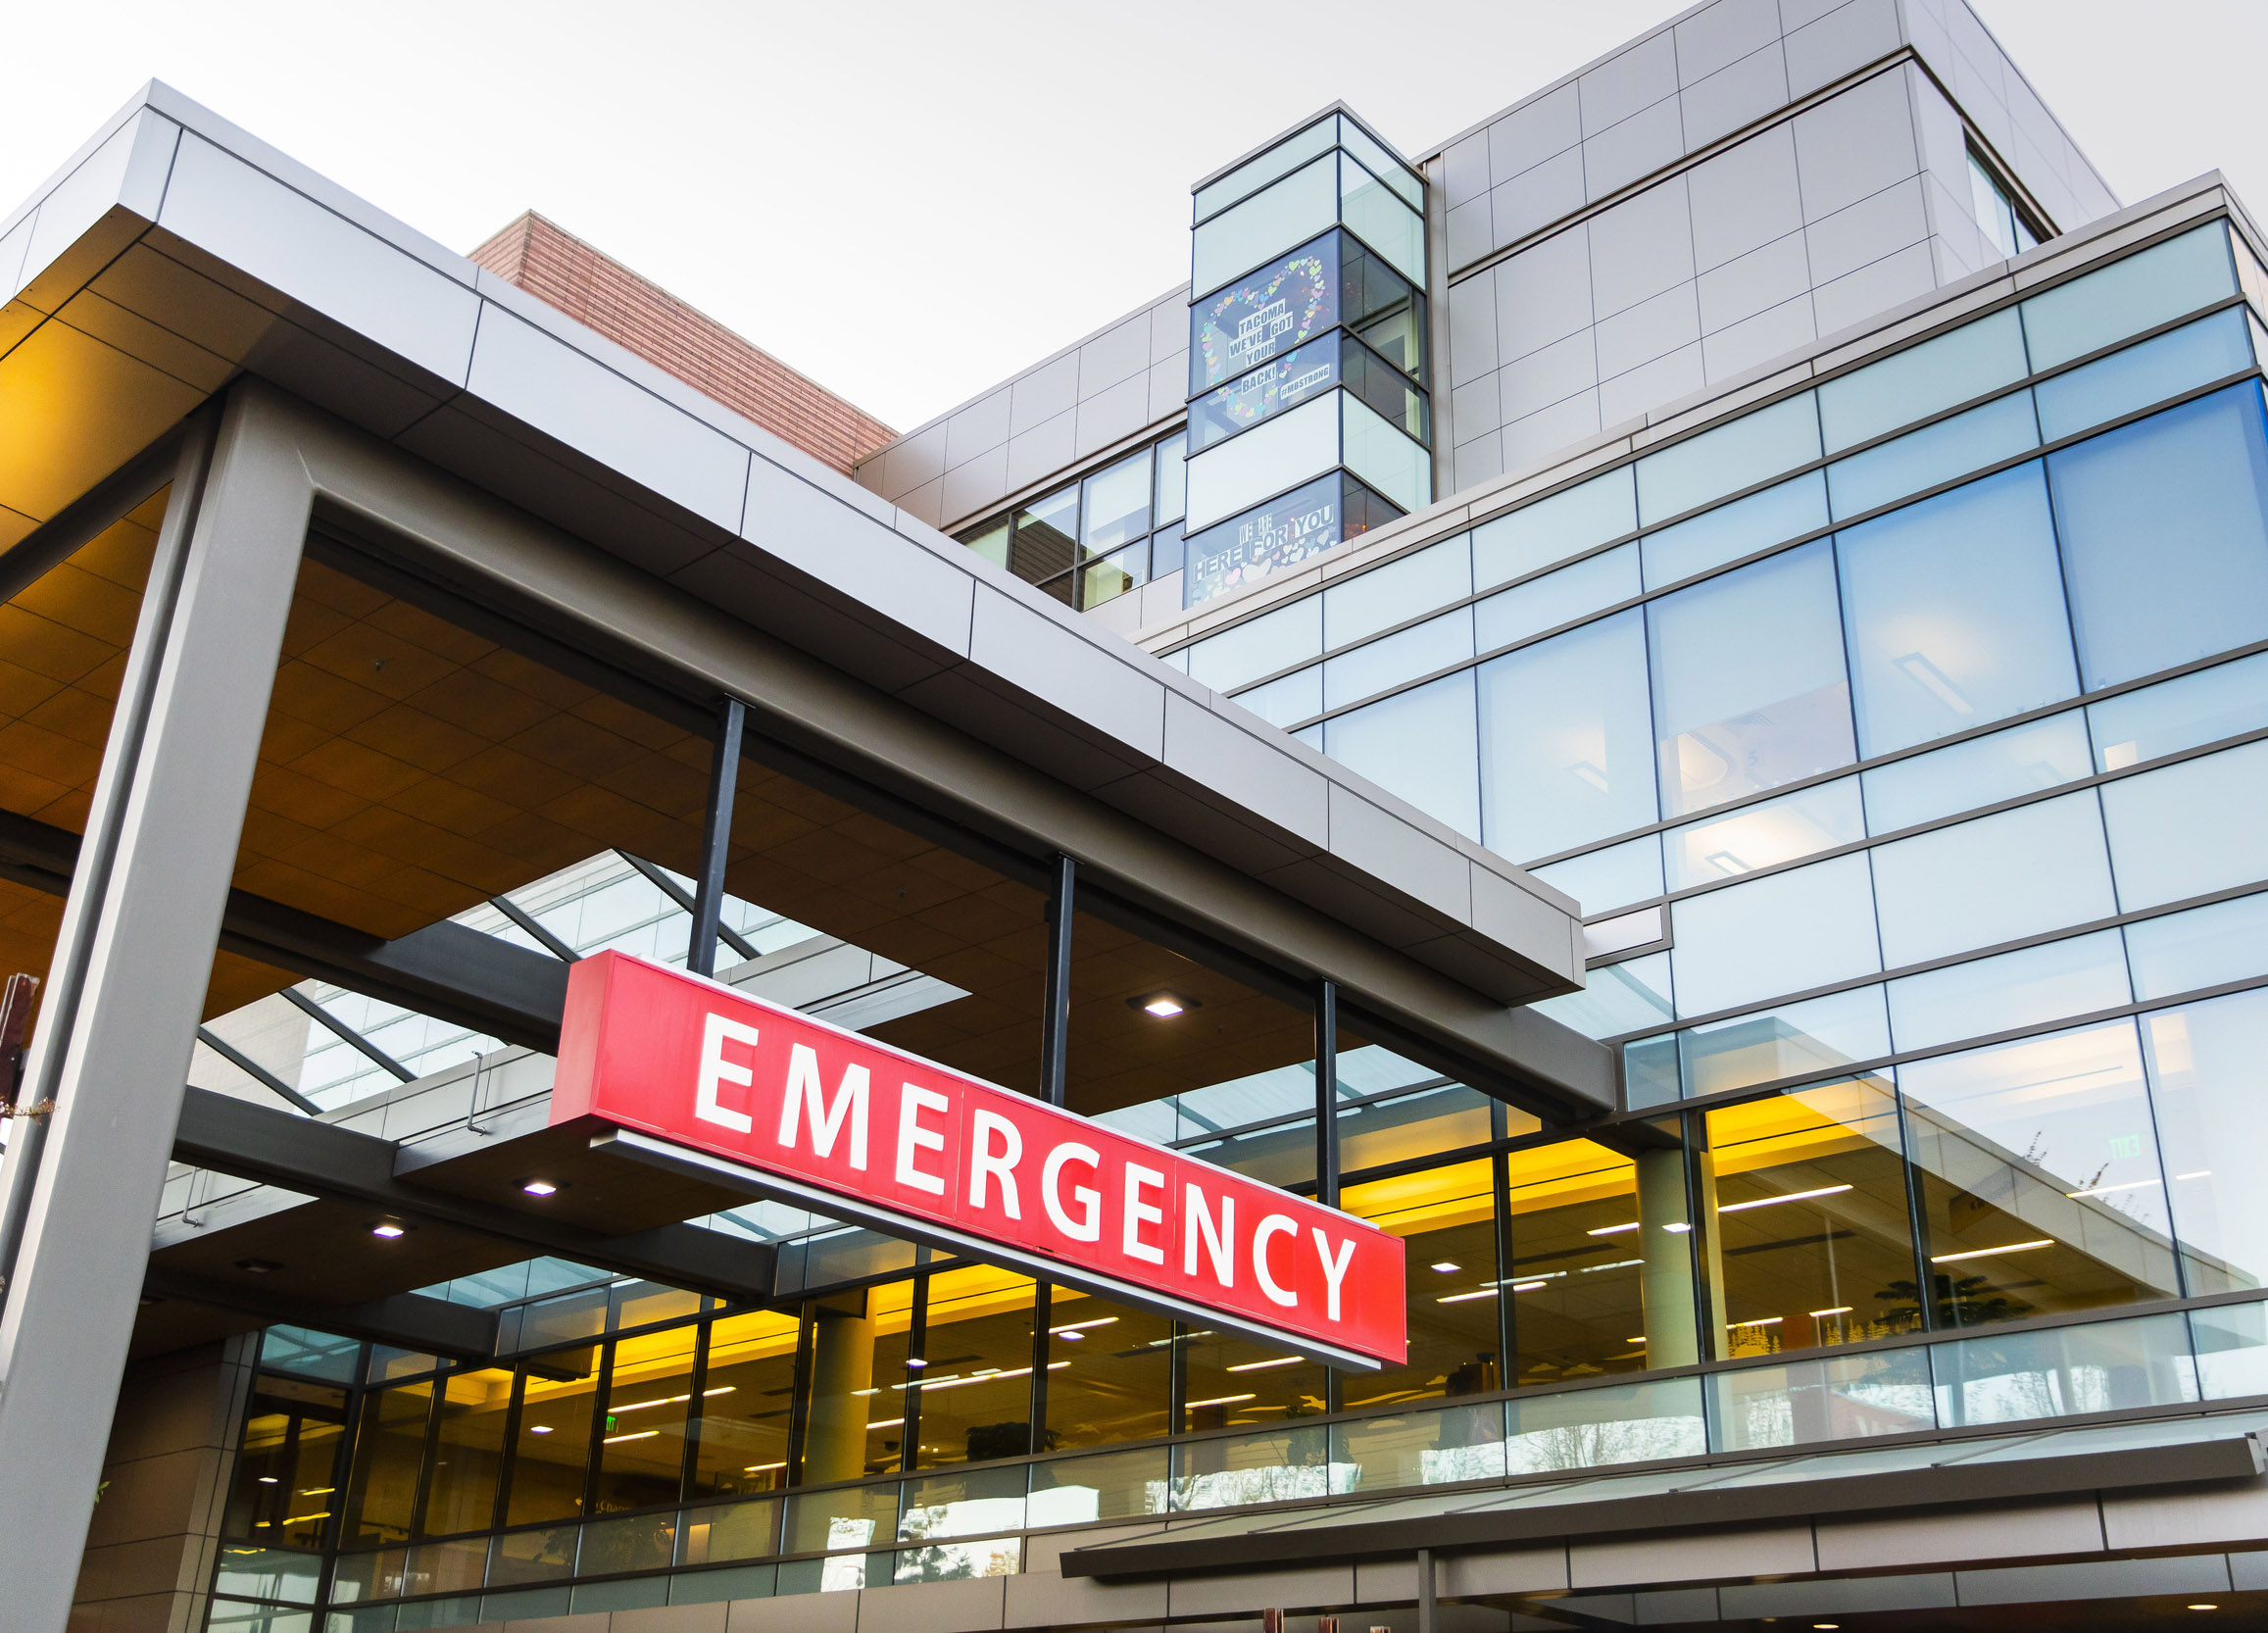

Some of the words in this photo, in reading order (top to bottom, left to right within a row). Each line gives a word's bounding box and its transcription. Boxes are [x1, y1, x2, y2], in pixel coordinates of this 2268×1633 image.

[1240, 303, 1285, 335] TACOMA
[1230, 330, 1262, 357] WE'VE
[1271, 316, 1292, 336] GOT
[1246, 341, 1275, 366] YOUR
[1242, 367, 1275, 393] BACK!
[1281, 368, 1329, 397] #MBSTRONG
[1194, 545, 1242, 581] HERE
[1251, 525, 1288, 559] FOR
[1296, 506, 1333, 536] YOU
[1240, 522, 1254, 544] WE
[1258, 514, 1272, 536] ARE
[696, 1012, 1357, 1322] EMERGENCY
